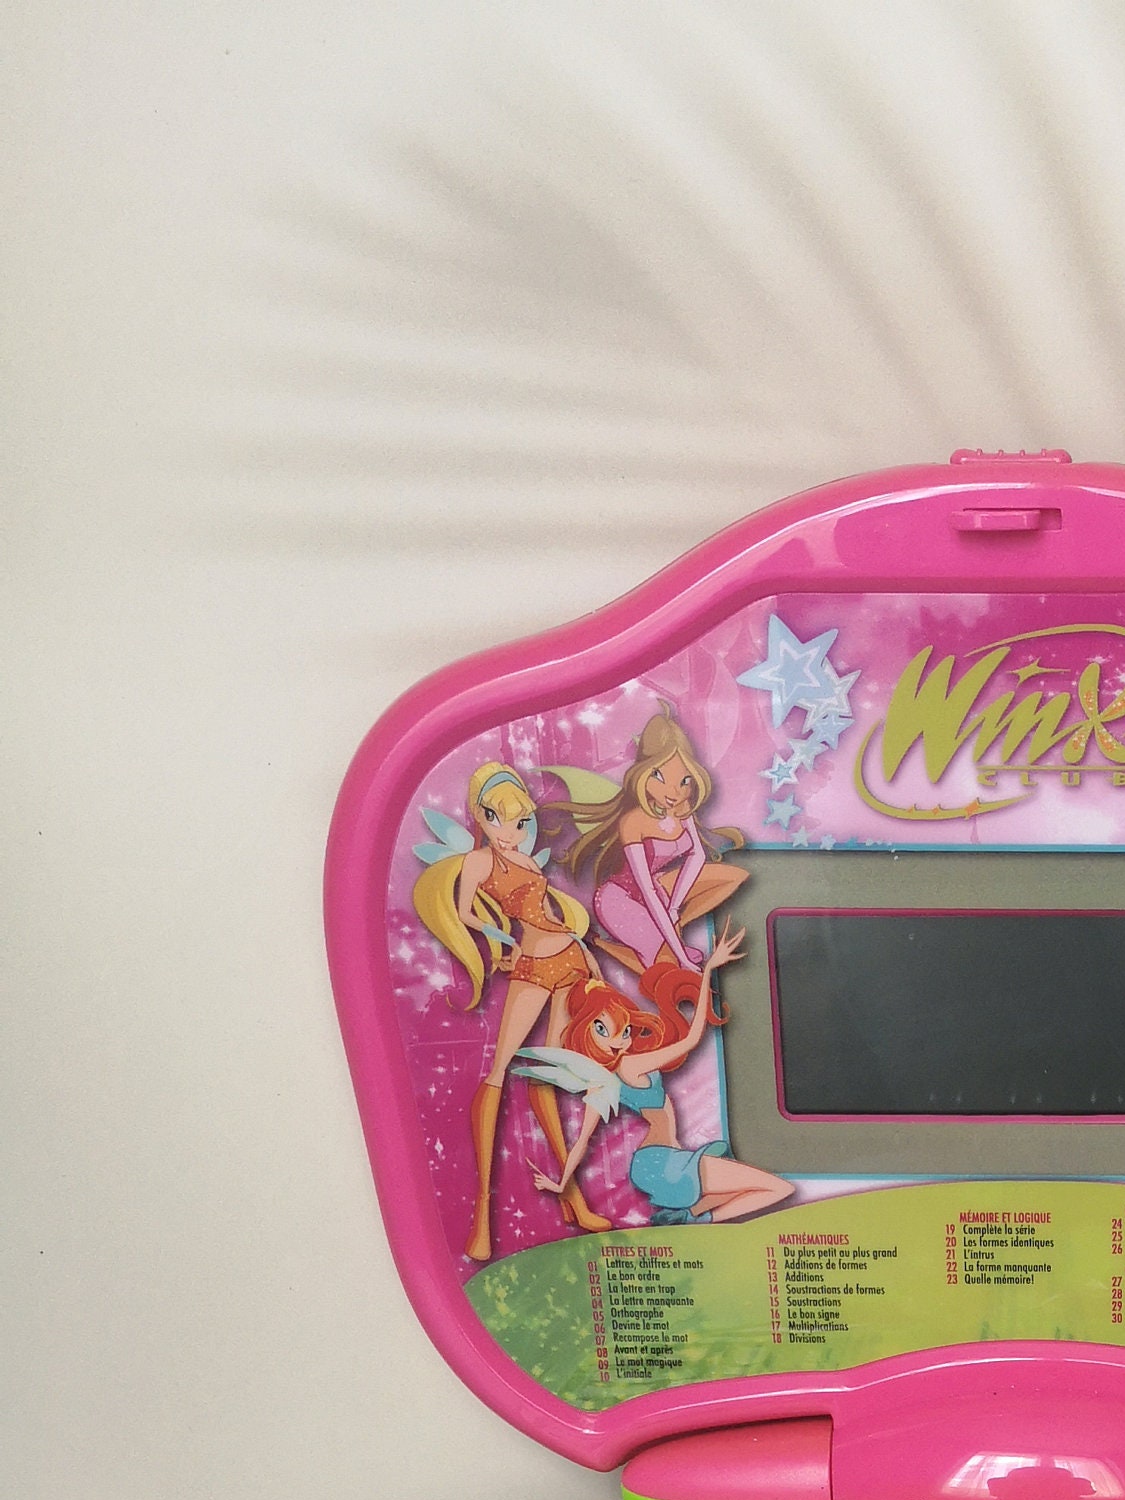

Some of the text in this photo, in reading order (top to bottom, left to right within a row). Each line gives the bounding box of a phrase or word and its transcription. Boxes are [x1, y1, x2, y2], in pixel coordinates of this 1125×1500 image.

[959, 1209, 1051, 1223] MÉMOIRE ET LOGIQUE
[963, 1223, 1035, 1237] Complète la série
[779, 1232, 849, 1245] MATHÉMATIQUES
[963, 1236, 1054, 1249] Les formes identiques
[601, 1247, 673, 1257] LETTRES ET MOTS
[784, 1246, 897, 1260] Du plus petit au plus grand
[964, 1249, 994, 1259] L'intrus
[606, 1258, 703, 1270] Lettres, chiffres et mots
[785, 1259, 867, 1270] Additions de formes
[964, 1261, 1051, 1273] La forme manquante
[607, 1271, 660, 1280] Le bon ordre
[785, 1272, 824, 1282] Additions
[964, 1273, 1034, 1284] Quelle mémoire!
[608, 1283, 618, 1293] La
[621, 1282, 642, 1293] lettre
[659, 1285, 675, 1295] trop
[786, 1284, 841, 1294] Soustractions
[843, 1284, 853, 1294] de
[609, 1295, 619, 1305] La
[646, 1298, 694, 1307] manquante
[787, 1297, 841, 1306] Soustractions
[611, 1308, 664, 1320] Orthographe
[788, 1308, 840, 1321] Le bon signe
[612, 1320, 640, 1330] Devine
[653, 1321, 669, 1330] mot
[789, 1321, 848, 1332] Multiplications
[672, 1334, 688, 1342] mot
[789, 1333, 825, 1343] Divisions
[614, 1345, 673, 1356] Avant et après
